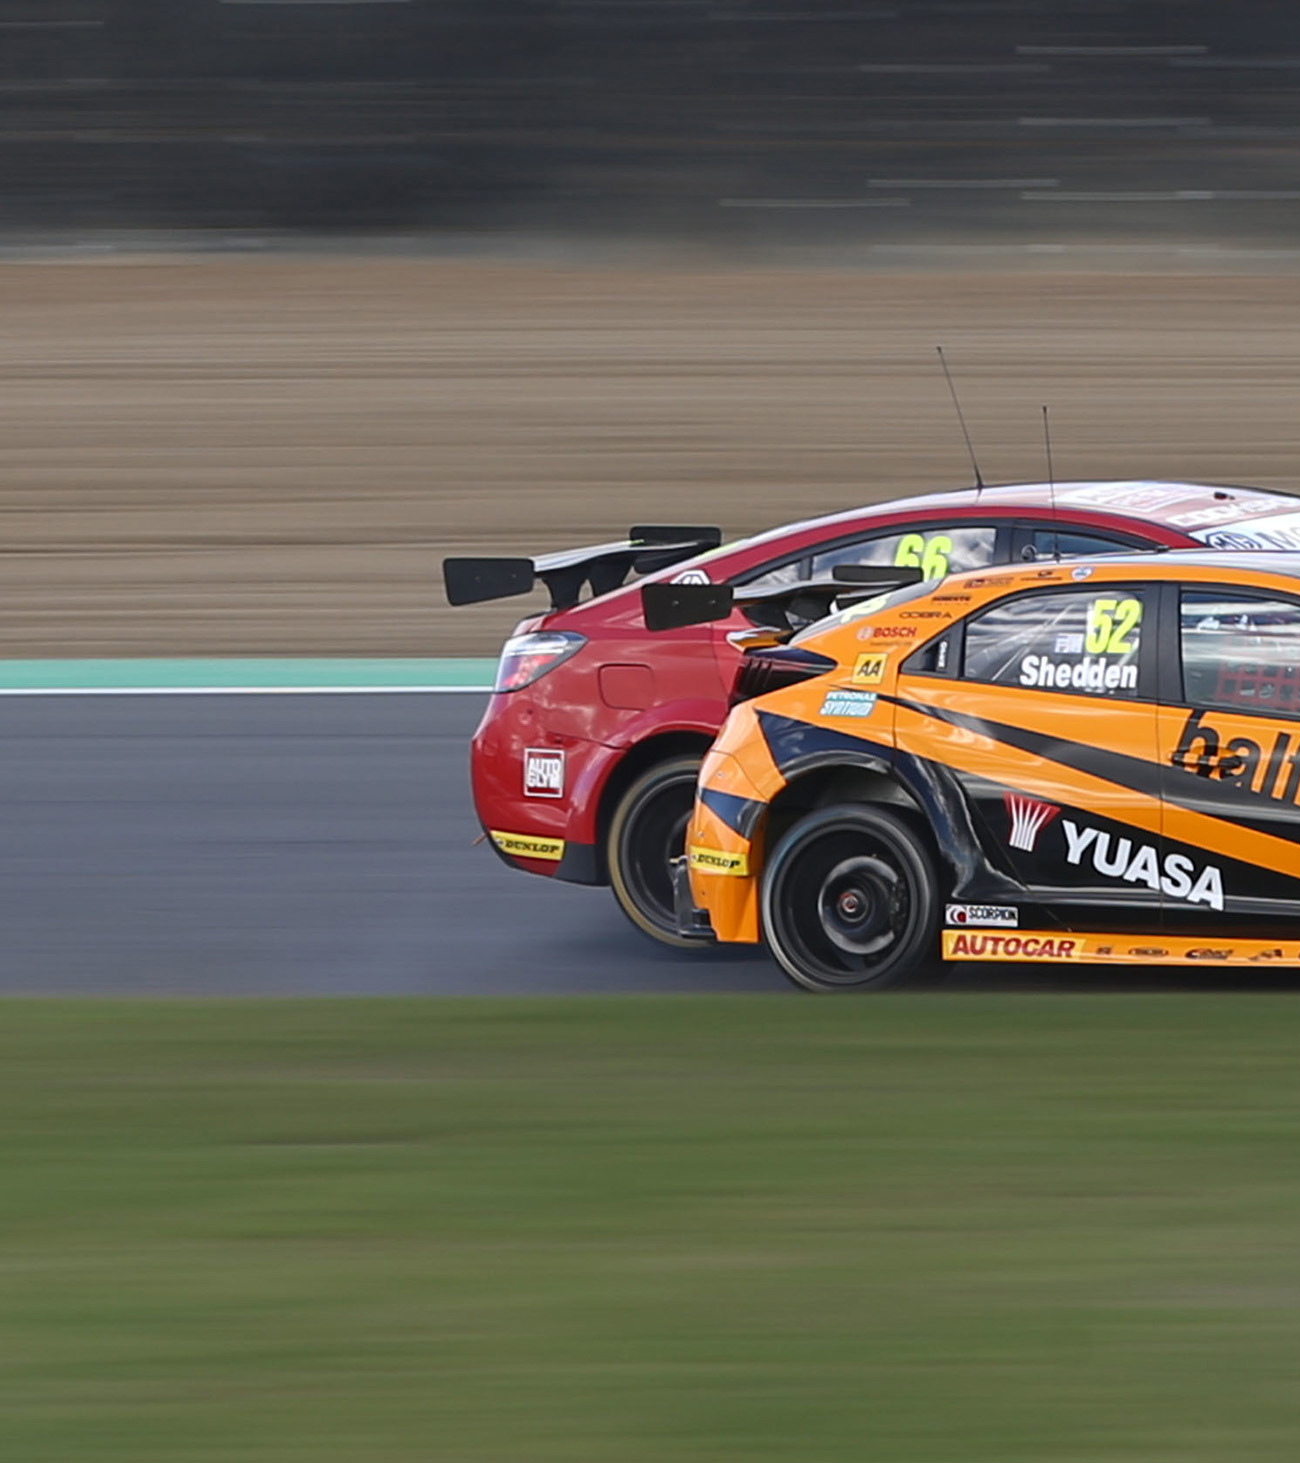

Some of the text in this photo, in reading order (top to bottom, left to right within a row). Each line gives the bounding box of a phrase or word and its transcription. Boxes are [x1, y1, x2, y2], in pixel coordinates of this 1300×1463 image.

[895, 535, 951, 579] 66
[899, 611, 952, 619] COBRA
[873, 627, 917, 637] BOSCH
[1086, 599, 1142, 653] 52
[857, 660, 882, 676] AA
[1019, 655, 1137, 690] Shedden
[505, 840, 561, 853] DUNLOP
[697, 854, 741, 868] DUNLOP
[1061, 820, 1225, 911] YUASA
[968, 907, 1017, 921] SCORPION
[952, 934, 1077, 958] AUTOCAR
